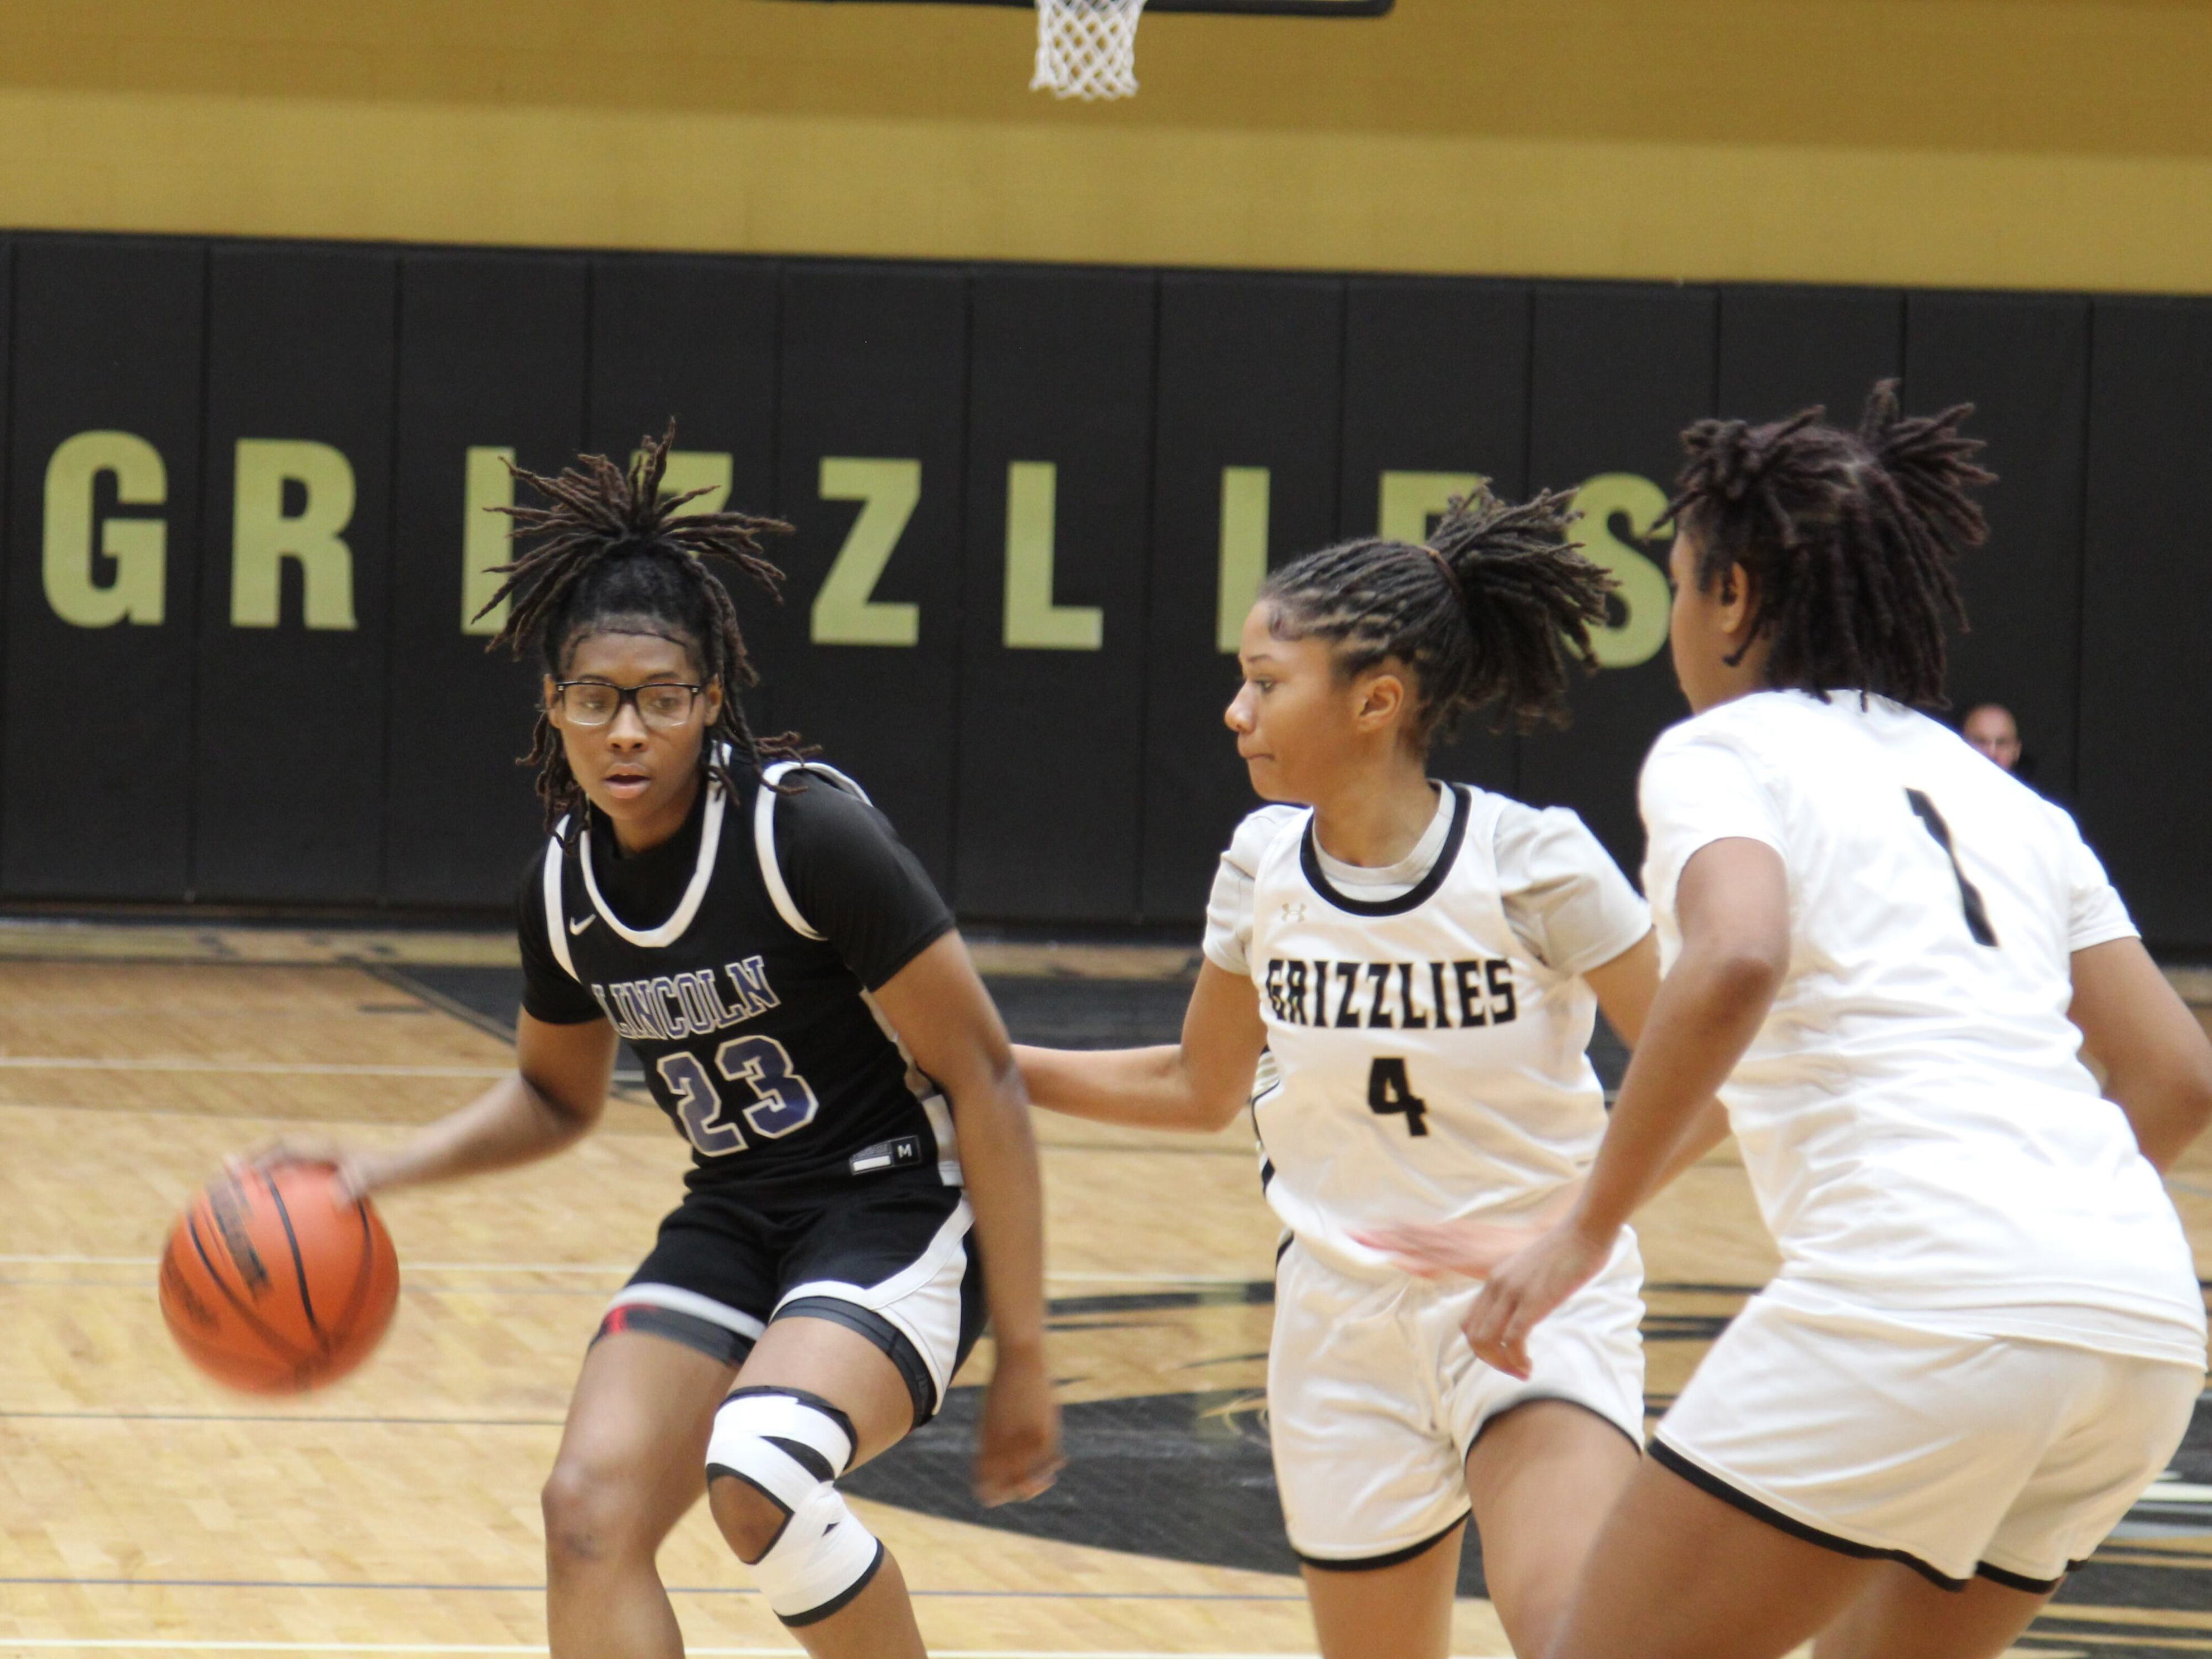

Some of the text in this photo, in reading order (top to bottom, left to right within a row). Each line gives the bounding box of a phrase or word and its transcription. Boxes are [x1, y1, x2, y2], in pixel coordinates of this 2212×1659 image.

[42, 430, 1675, 668] GRIZLIS
[1903, 787, 1998, 947] 1
[591, 954, 781, 1040] LINCOLN
[1266, 959, 1517, 1029] GRIZZLIES
[657, 1035, 819, 1158] 23
[1367, 1057, 1428, 1137] 4
[897, 1143, 912, 1159] M
